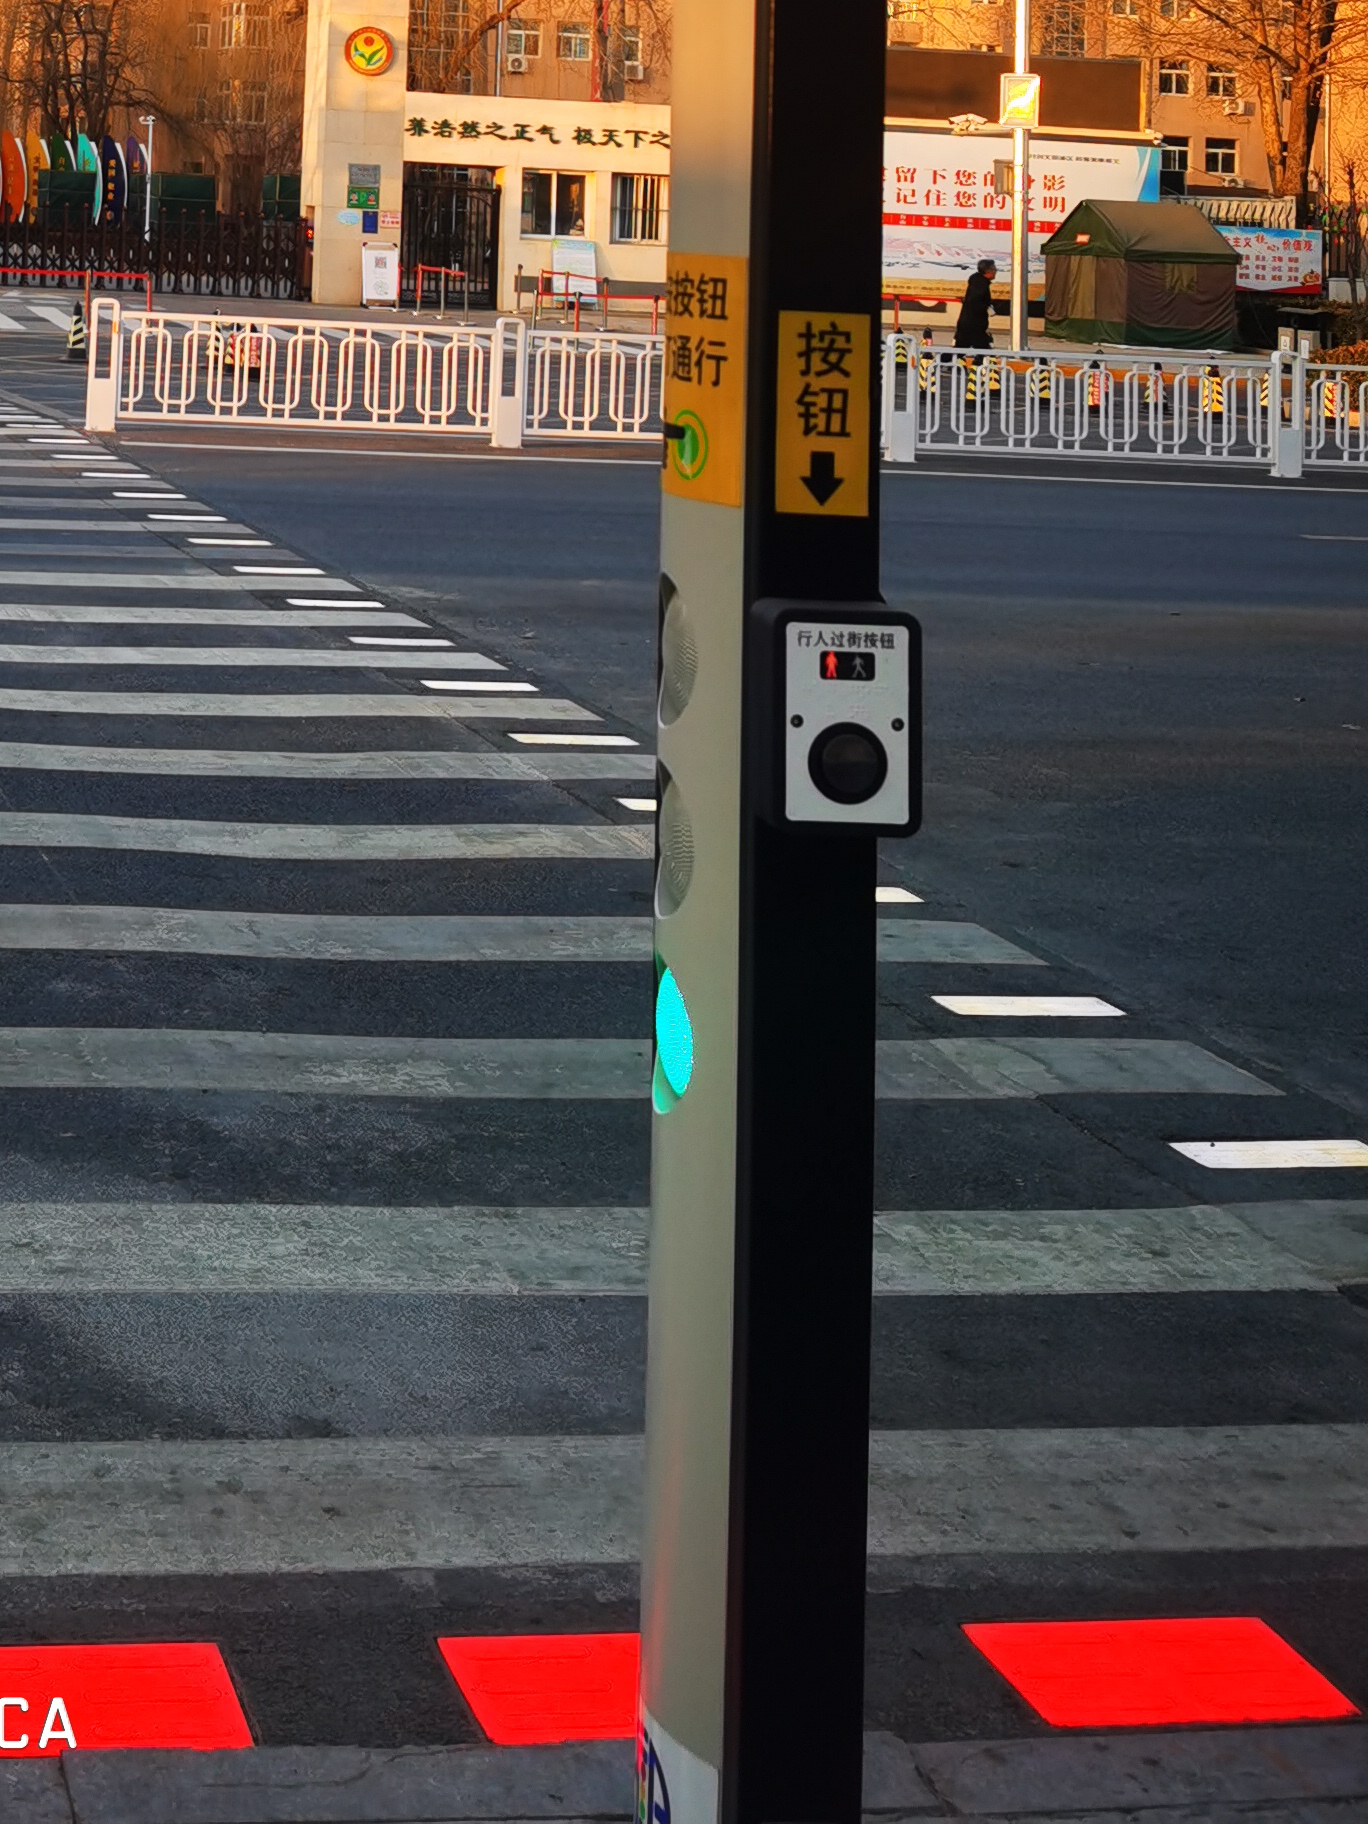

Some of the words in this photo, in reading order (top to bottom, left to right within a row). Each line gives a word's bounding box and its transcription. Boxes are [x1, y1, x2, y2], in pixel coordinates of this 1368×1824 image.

[405, 117, 561, 145] 养浩然之正气
[882, 165, 1066, 192] 留下您的影
[882, 186, 1066, 213] 记住您的明
[666, 270, 729, 321] 按钮
[795, 321, 853, 438] 按钮
[797, 630, 896, 650] 行人过街按钮
